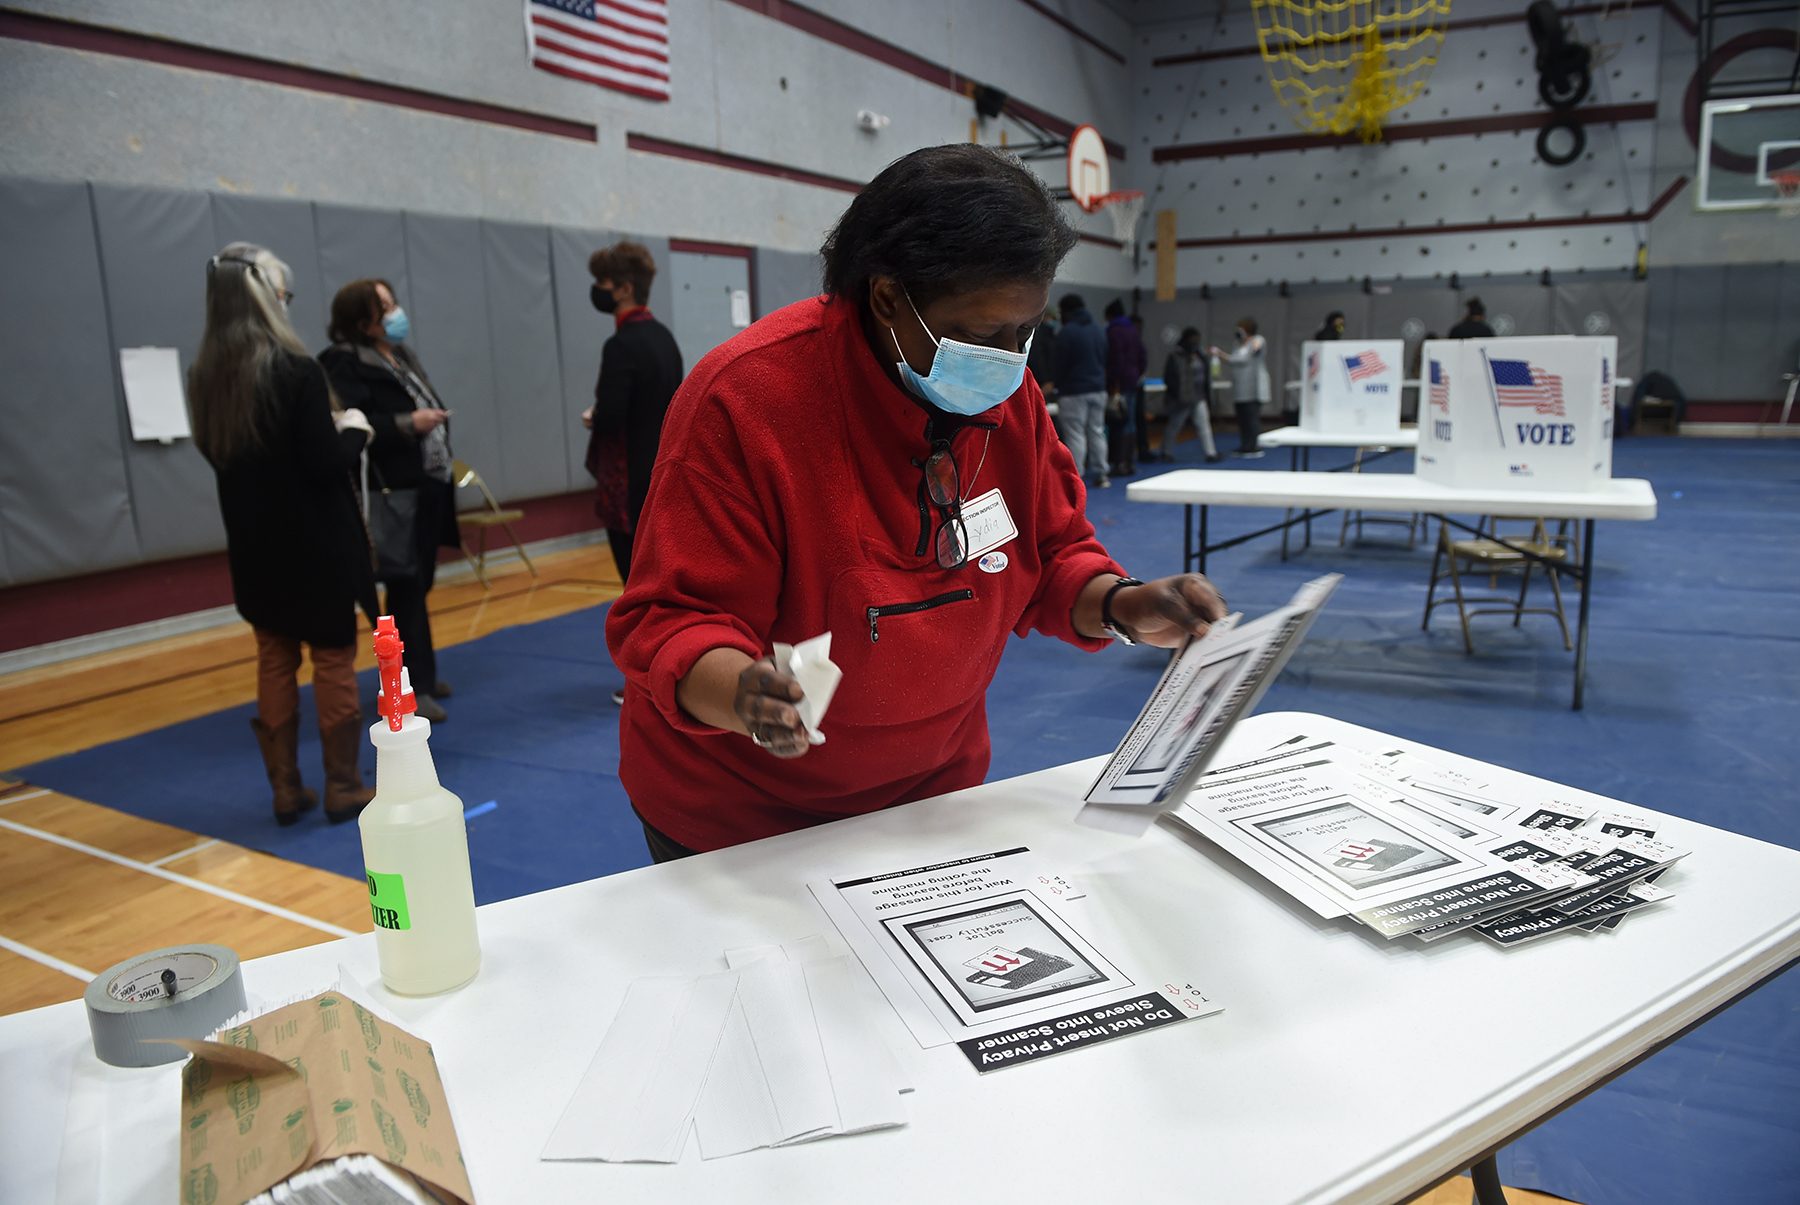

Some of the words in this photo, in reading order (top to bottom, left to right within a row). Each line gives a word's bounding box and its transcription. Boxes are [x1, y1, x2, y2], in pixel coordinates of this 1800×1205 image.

[1365, 383, 1388, 393] VOTE
[1516, 423, 1575, 445] VOTE
[961, 511, 980, 522] ECTION
[980, 502, 1000, 517] INSPECTOR
[1207, 787, 1252, 800] machine
[1227, 792, 1267, 804] leaving
[1218, 800, 1267, 814] message
[975, 853, 996, 862] Return
[1623, 859, 1647, 868] Do
[871, 871, 903, 882] finished
[904, 867, 926, 875] when
[973, 867, 991, 877] the
[1600, 865, 1629, 880] Not
[928, 871, 971, 887] voting
[943, 877, 984, 891] before
[987, 878, 1013, 890] Wait
[1463, 876, 1512, 894] Sleeve
[871, 880, 927, 896] machine
[892, 885, 942, 900] leaving
[944, 887, 966, 899] this
[966, 884, 984, 894] for
[1433, 889, 1462, 901] Into
[1480, 889, 1508, 901] Not
[1510, 883, 1534, 893] Do
[875, 893, 936, 911] message
[1372, 899, 1434, 919] Scanner
[1441, 896, 1478, 913] Insert
[1591, 902, 1616, 916] Not
[958, 916, 1033, 935] Successfully
[1381, 910, 1441, 929] Privacy
[1495, 917, 1551, 938] Privacy
[926, 934, 953, 943] Cast
[967, 929, 1005, 941] Ballot
[138, 987, 160, 1002] 3900
[1093, 999, 1154, 1020] Sleeve
[1144, 1008, 1173, 1021] Do
[1055, 1013, 1094, 1030] Into
[1107, 1015, 1145, 1032] Not
[977, 1023, 1054, 1051] Scanner
[1055, 1023, 1107, 1047] Insert
[982, 1041, 1054, 1065] Privacy
